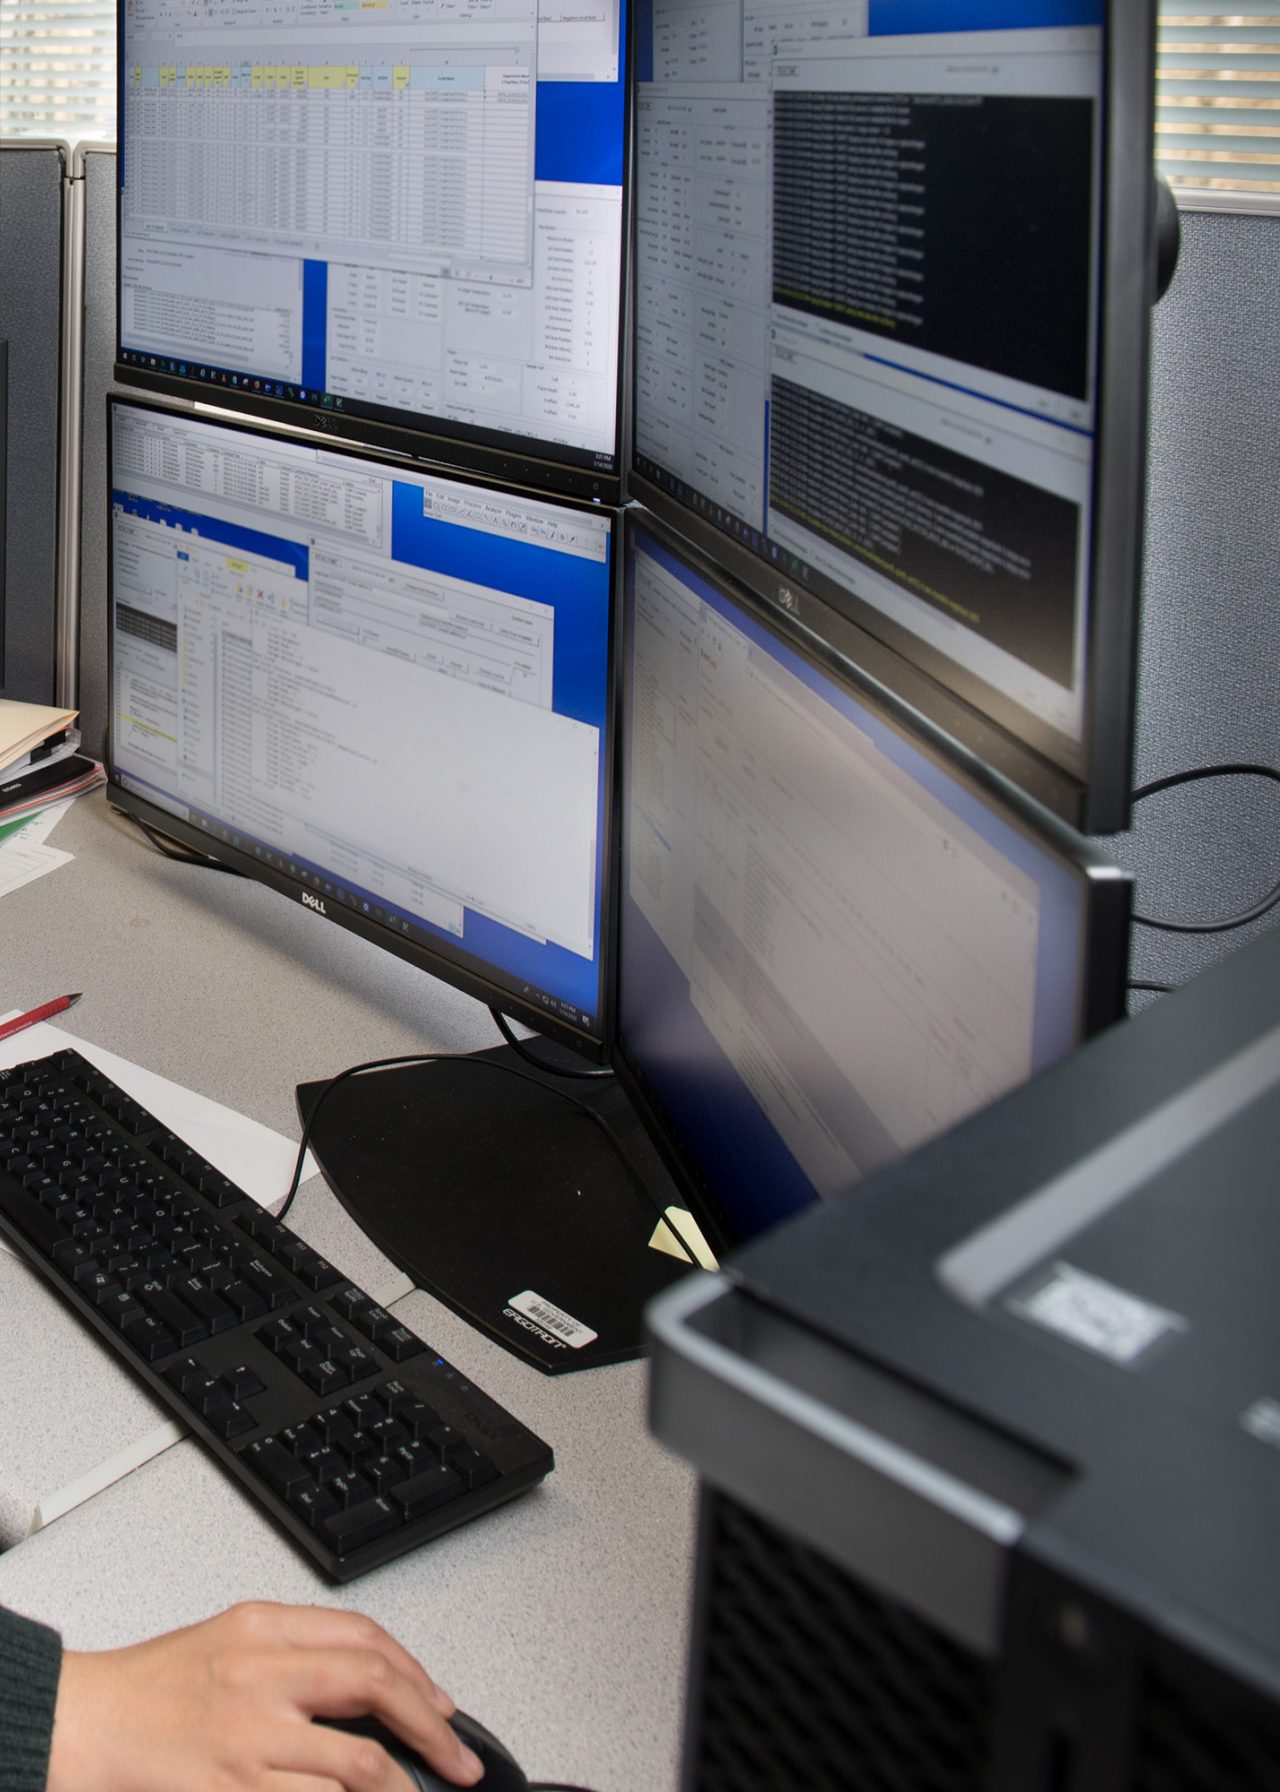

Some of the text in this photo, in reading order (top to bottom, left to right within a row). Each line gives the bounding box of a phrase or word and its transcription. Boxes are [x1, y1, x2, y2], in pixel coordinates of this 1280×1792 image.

[314, 413, 338, 432] DELL
[447, 495, 461, 504] Image
[463, 498, 482, 510] Process
[485, 505, 503, 514] Analyze
[505, 510, 522, 519] Plugins
[526, 515, 544, 525] Window
[547, 520, 559, 529] Help
[302, 891, 326, 914] DELL
